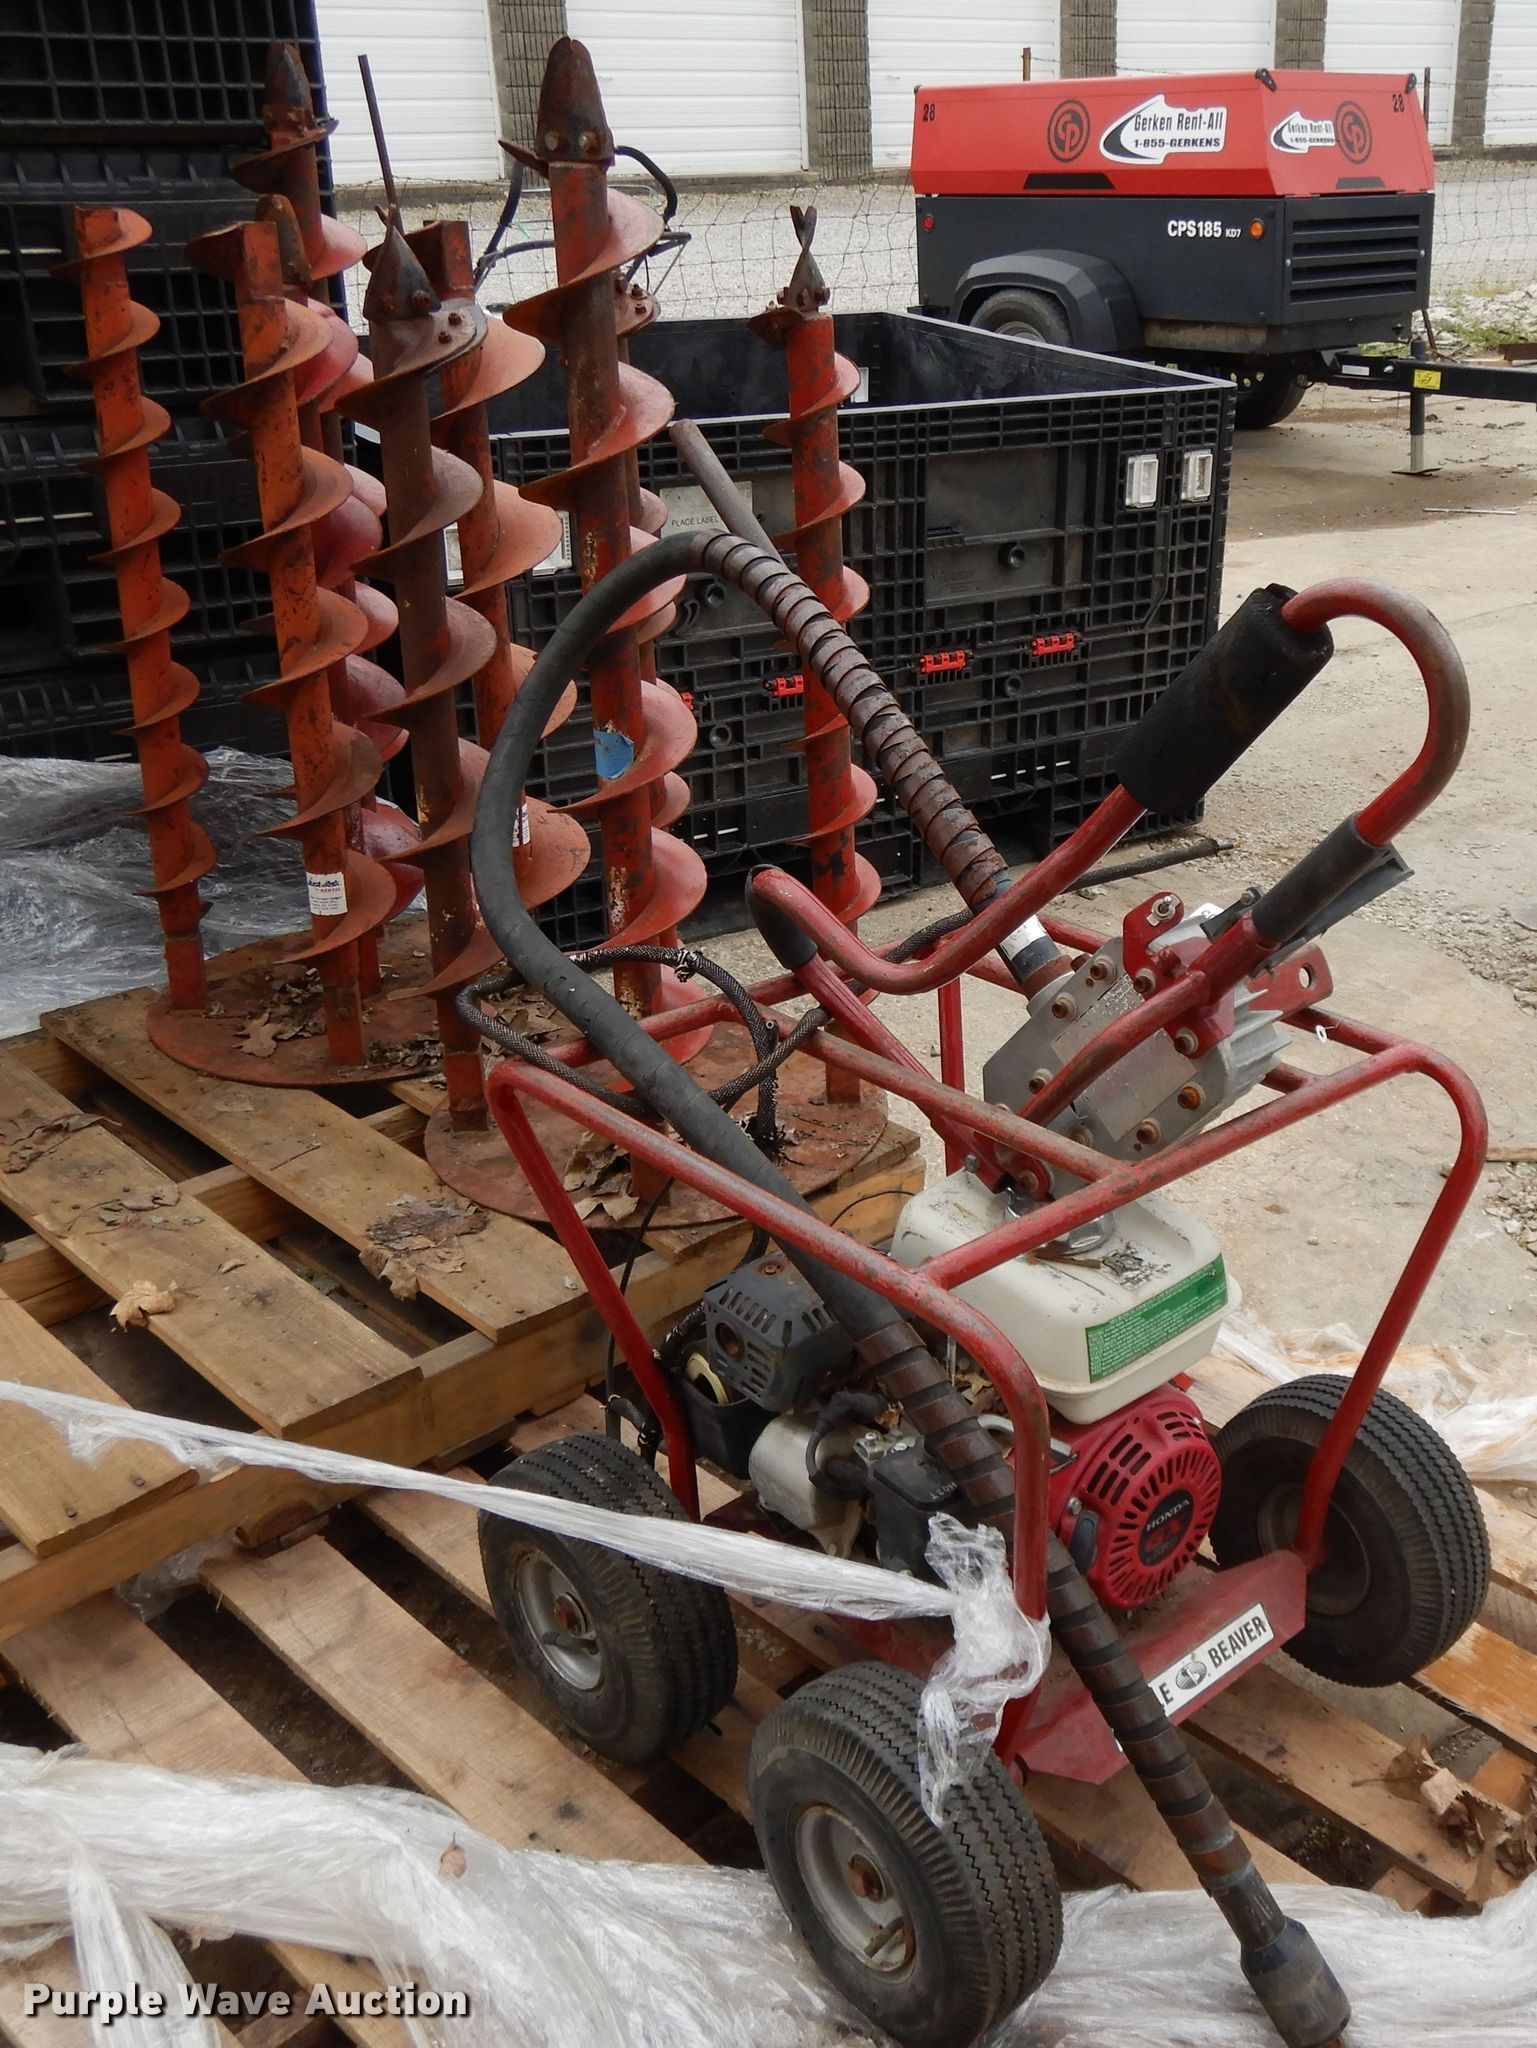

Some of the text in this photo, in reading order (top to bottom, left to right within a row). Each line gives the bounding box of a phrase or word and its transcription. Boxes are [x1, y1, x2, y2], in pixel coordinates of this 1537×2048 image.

[922, 103, 936, 122] 28
[1392, 93, 1405, 113] 28
[1134, 111, 1223, 132] Gerken Rent-All
[1134, 137, 1221, 149] 1-855-GERKENS
[1167, 219, 1241, 238] CPS185 KD7
[671, 515, 720, 528] PLACE LABEL
[1146, 1499, 1190, 1532] HONDA
[1207, 1615, 1268, 1670] BEAVER
